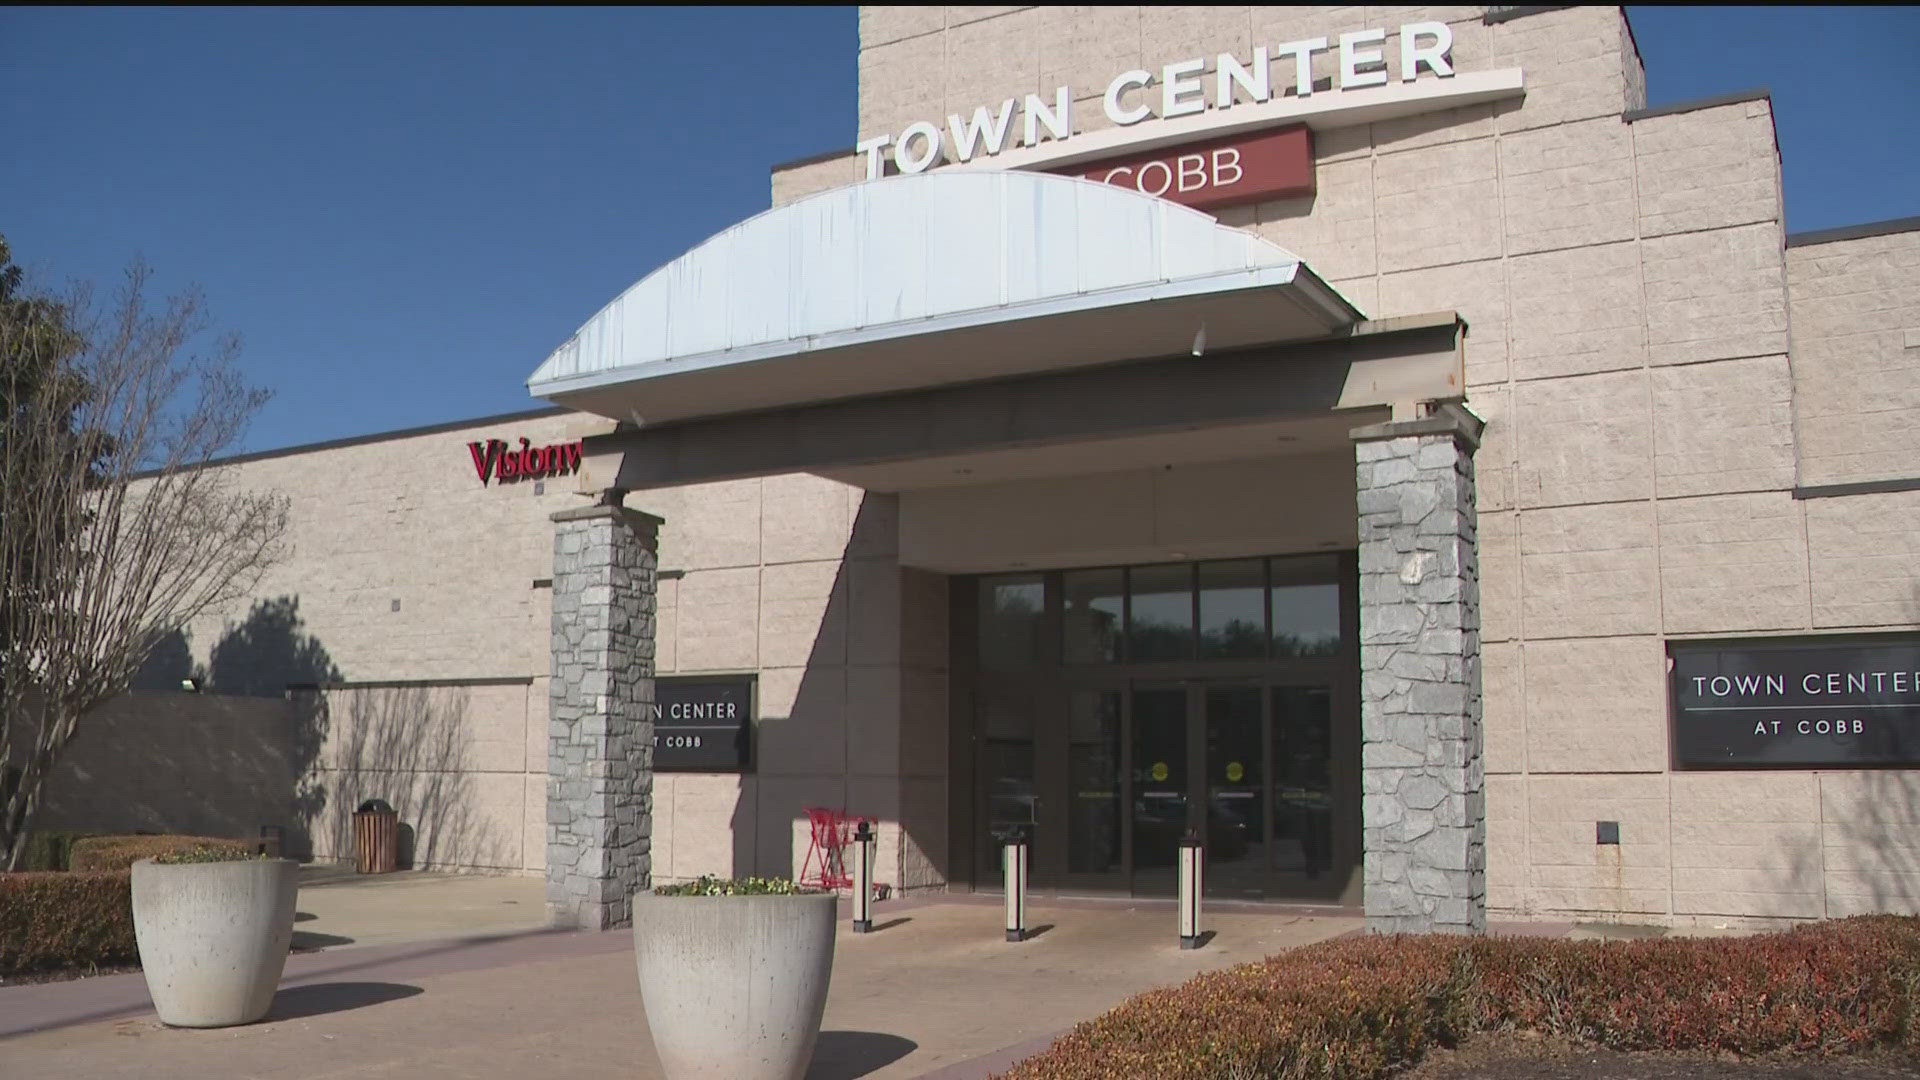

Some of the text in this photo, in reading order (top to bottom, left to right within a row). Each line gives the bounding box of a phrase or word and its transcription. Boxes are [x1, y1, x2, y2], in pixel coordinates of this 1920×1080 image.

[857, 21, 1454, 181] TOWN CENTER
[1693, 674, 1785, 697] TOWN
[670, 703, 736, 719] CENTER
[1754, 719, 1864, 735] AT COBB
[666, 736, 701, 748] COBB
